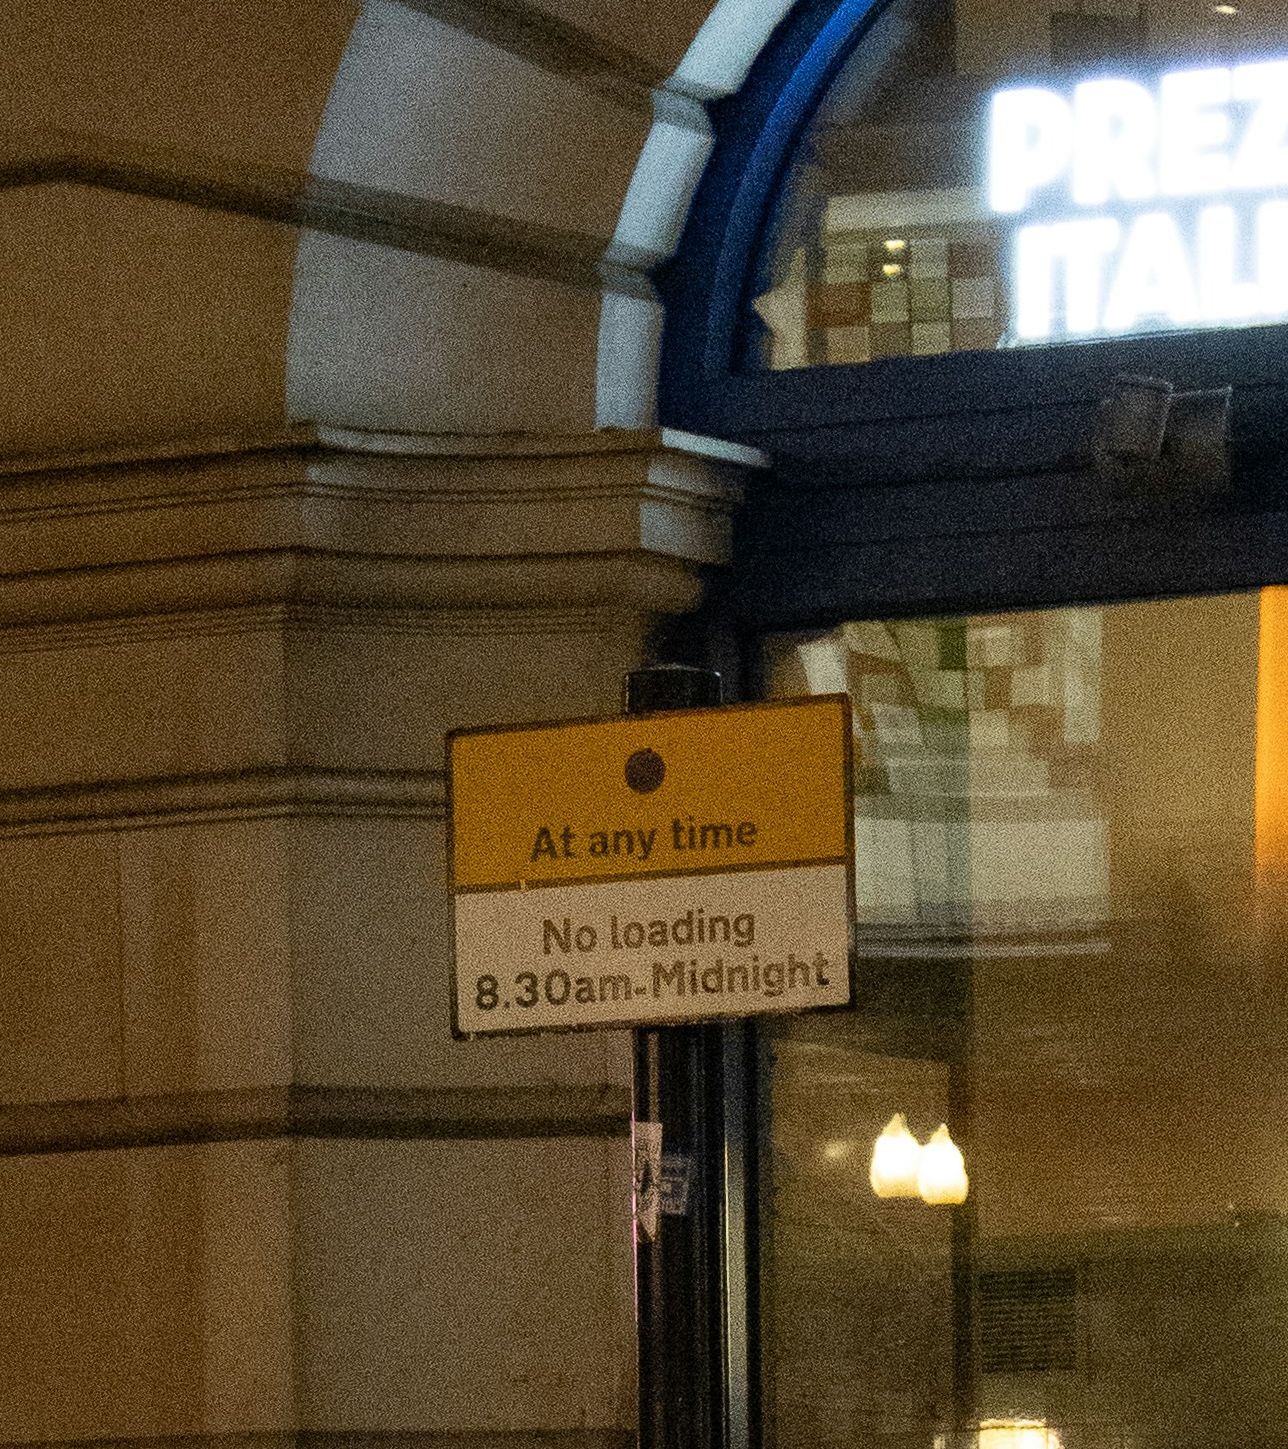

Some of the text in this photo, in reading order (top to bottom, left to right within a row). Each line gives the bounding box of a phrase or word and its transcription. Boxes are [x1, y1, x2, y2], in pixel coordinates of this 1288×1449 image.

[530, 814, 759, 863] At any time
[541, 907, 756, 955] No loading
